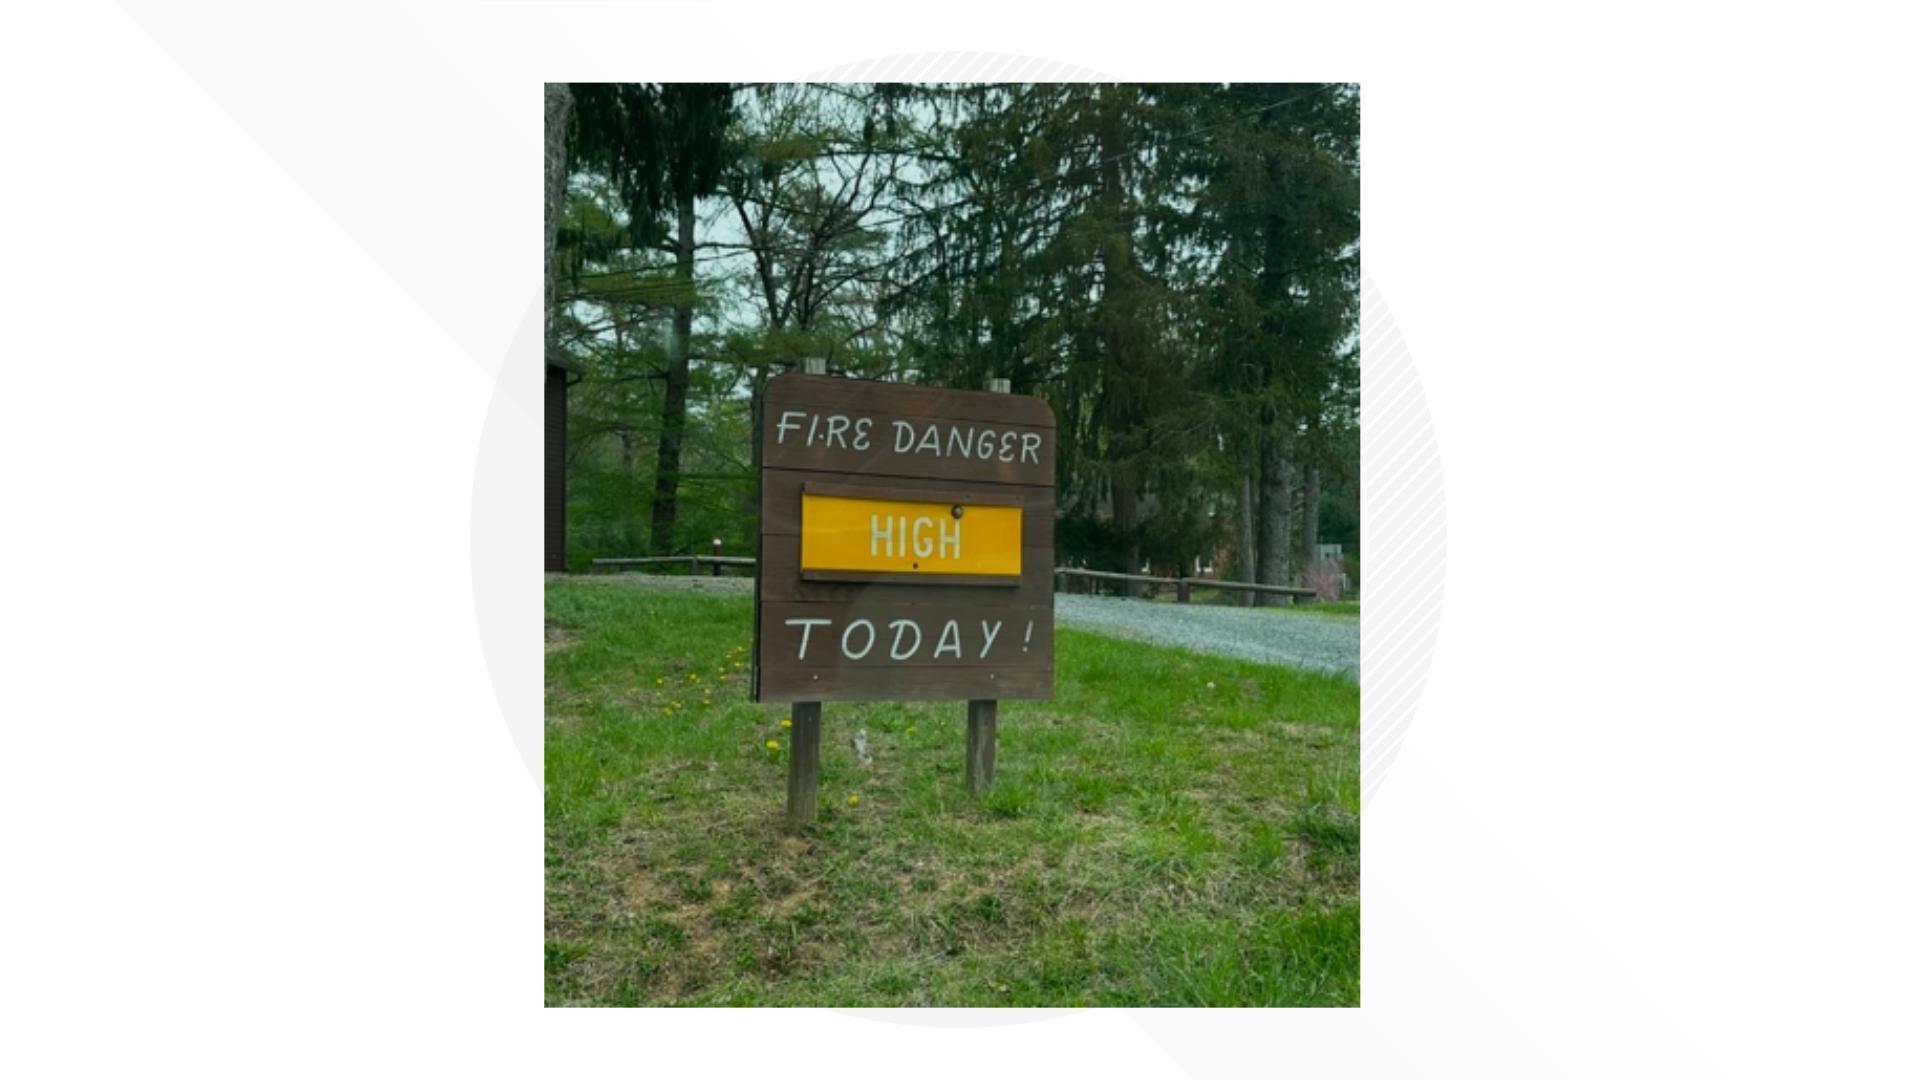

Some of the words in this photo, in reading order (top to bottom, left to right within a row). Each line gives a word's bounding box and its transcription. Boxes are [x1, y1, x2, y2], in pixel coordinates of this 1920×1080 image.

[776, 411, 873, 450] FIRE
[892, 420, 1042, 464] DANGER
[870, 514, 961, 559] HIGH
